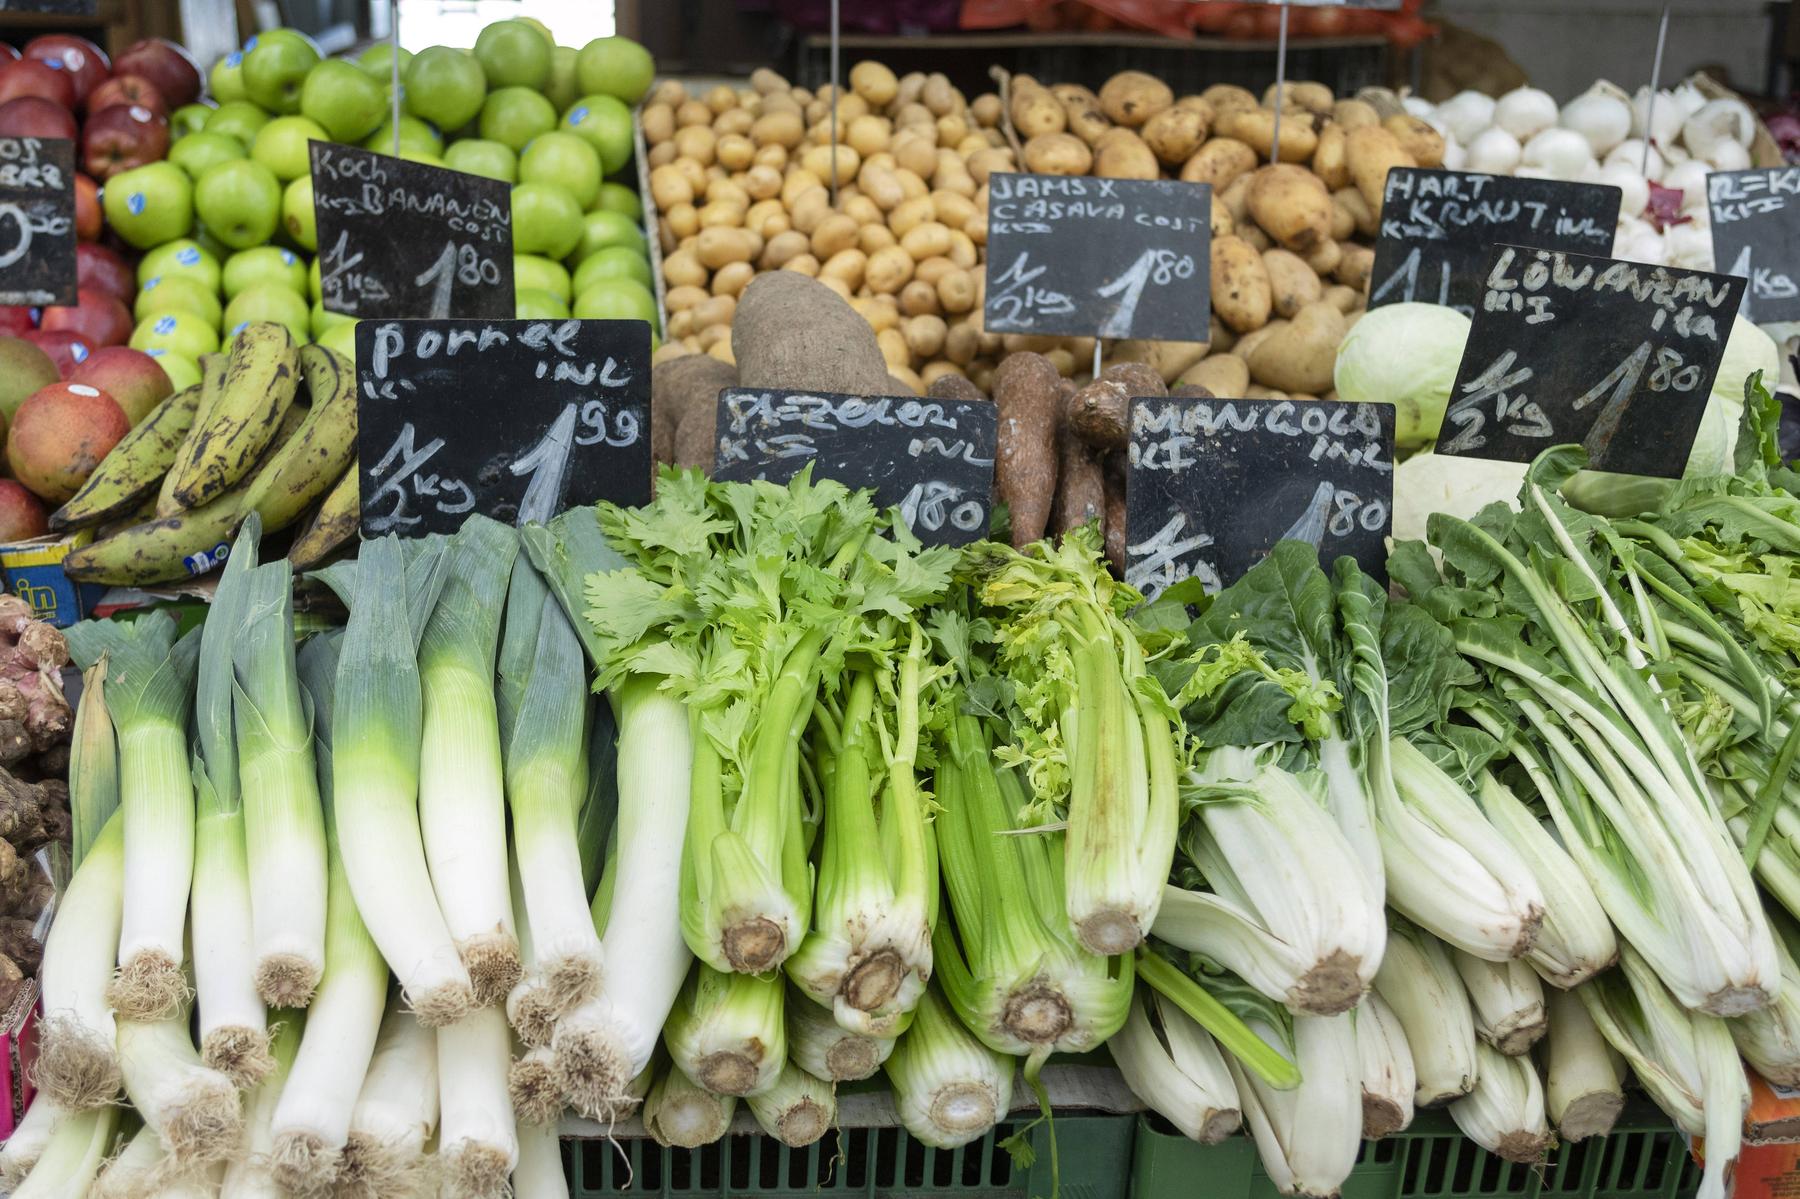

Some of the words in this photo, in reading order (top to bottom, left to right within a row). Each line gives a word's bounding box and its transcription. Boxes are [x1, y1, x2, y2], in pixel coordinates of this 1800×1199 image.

[991, 176, 1088, 200] JAMS
[1385, 172, 1495, 203] HART
[993, 199, 1126, 220] CASAVA
[1410, 199, 1548, 229] KRAUT
